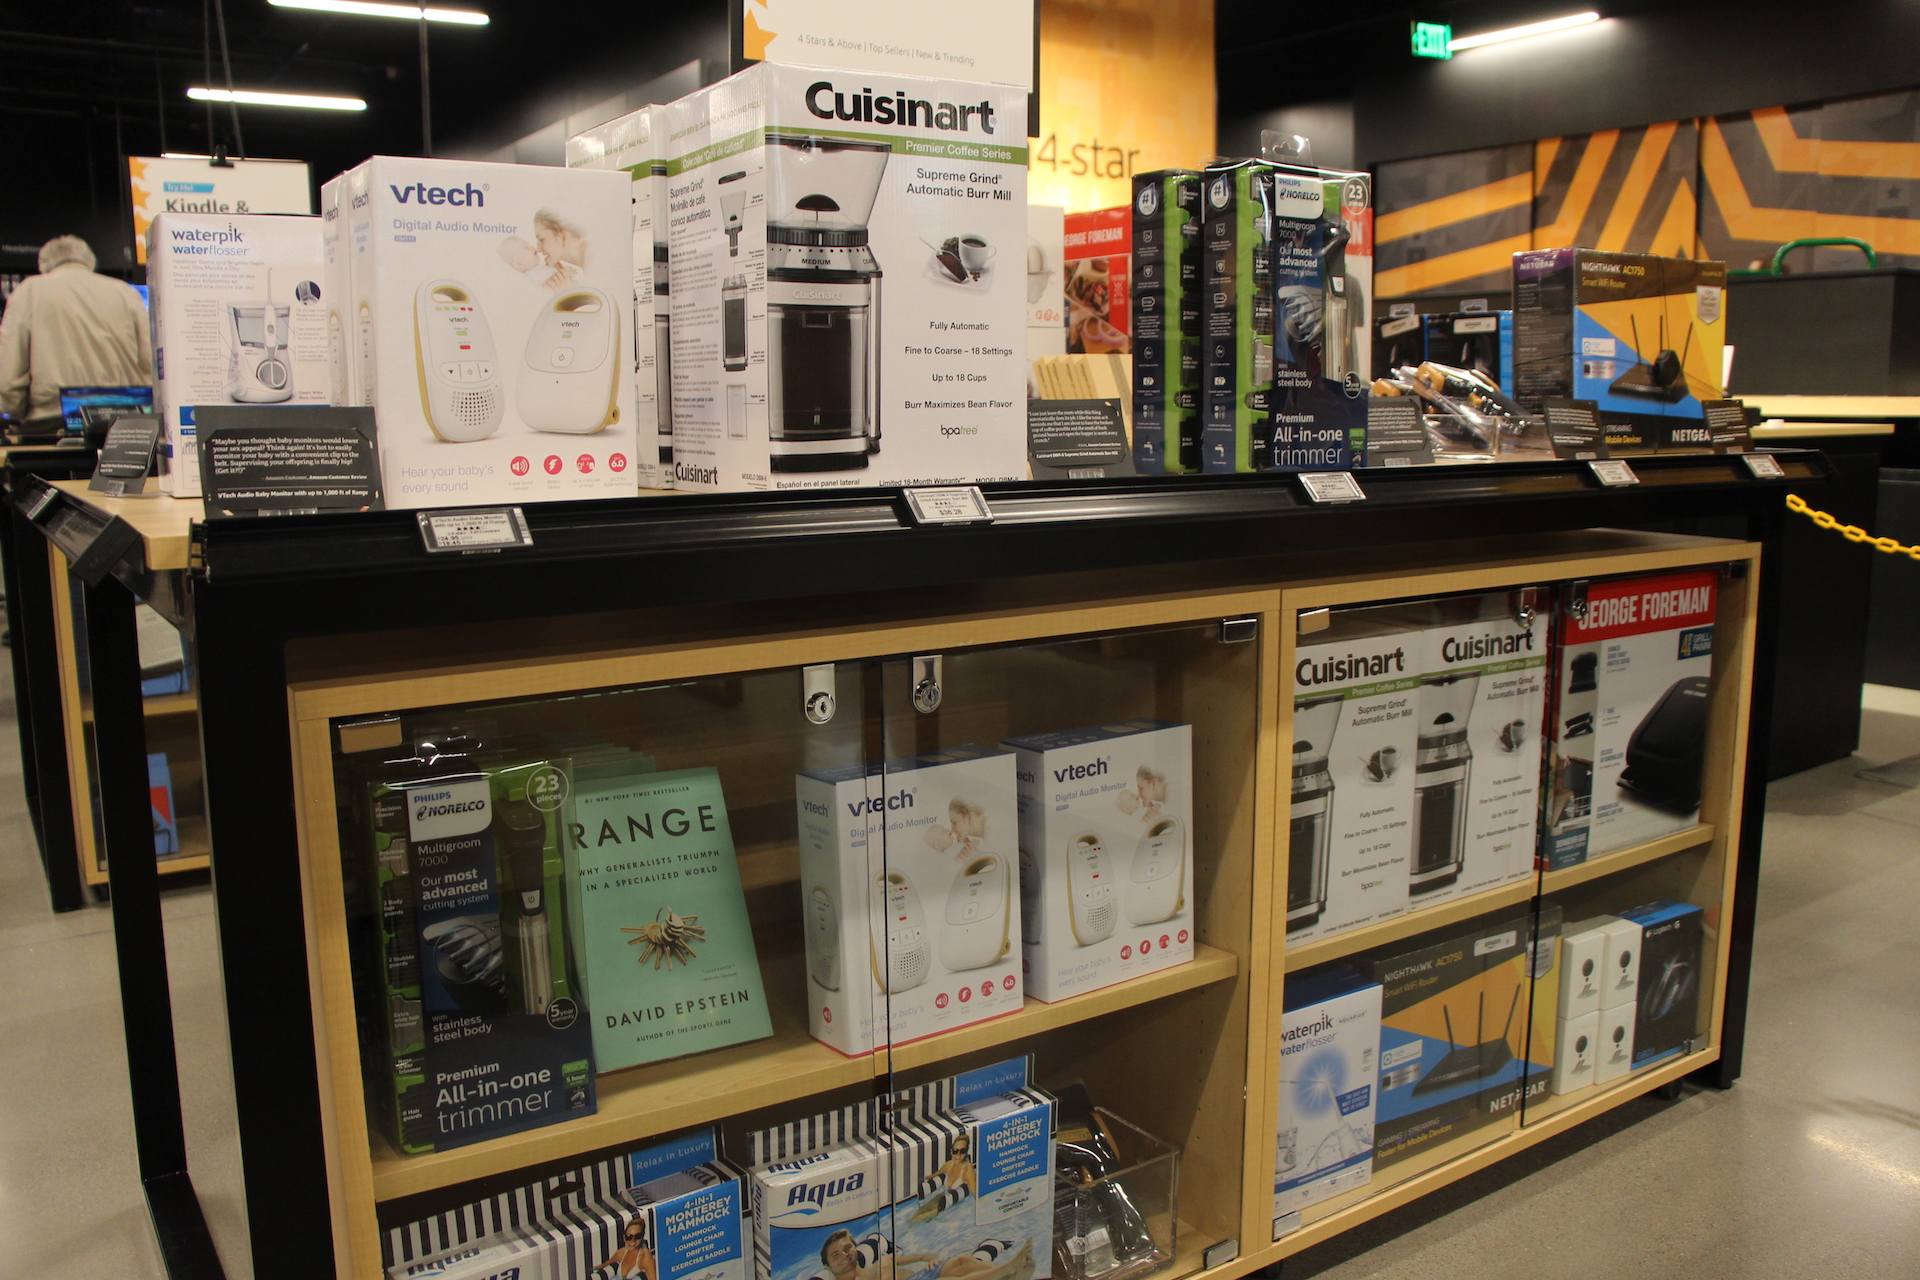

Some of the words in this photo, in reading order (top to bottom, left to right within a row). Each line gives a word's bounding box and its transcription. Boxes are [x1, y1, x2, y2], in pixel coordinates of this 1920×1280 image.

[798, 34, 803, 43] 4
[806, 35, 826, 46] Stars
[828, 38, 835, 47] &
[837, 39, 862, 50] Above
[869, 43, 883, 54] Top
[885, 45, 910, 57] Sellers
[916, 49, 932, 59] New
[935, 51, 941, 60] &
[943, 53, 974, 66] Trending
[805, 81, 994, 135] Cuisinart
[906, 140, 944, 154] Premier
[947, 144, 979, 157] Coffee
[982, 147, 1012, 160] Series
[1037, 133, 1140, 179] 4-star
[917, 168, 965, 183] Supreme
[970, 173, 998, 184] Grind
[390, 183, 483, 207] vtech
[907, 184, 963, 197] Automatic
[967, 189, 989, 199] Burr
[993, 189, 1011, 201] Mill
[1287, 190, 1319, 200] NORELCO
[1349, 185, 1362, 199] 23
[166, 200, 229, 212] Kindle
[172, 223, 243, 244] waterpik
[393, 219, 431, 231] Digital
[435, 221, 469, 232] Audio
[473, 223, 517, 234] Monitor
[1280, 220, 1316, 231] Multigroom
[1280, 231, 1296, 239] 7000
[173, 245, 248, 256] waterflosser
[1293, 247, 1312, 256] most
[802, 258, 831, 266] MEDIUM
[1280, 258, 1317, 267] advanced
[1582, 262, 1620, 273] NIGHTHAWK
[1622, 266, 1645, 276] AC1750
[1582, 277, 1597, 286] Smart
[930, 322, 947, 330] Fully
[950, 322, 989, 331] Automatic
[905, 347, 921, 355] Fine
[924, 347, 932, 355] to
[935, 347, 962, 355] Coarse
[971, 347, 979, 355] 18
[982, 347, 1012, 356] Settings
[932, 374, 943, 383] Up
[956, 374, 965, 382] 18
[967, 374, 987, 383] Cups
[1295, 379, 1312, 388] body
[925, 400, 965, 408] Maximizes
[968, 400, 987, 408] Bean
[990, 400, 1012, 408] Flavor
[1276, 413, 1314, 423] Premium
[941, 425, 977, 439] bpafree
[1274, 427, 1343, 442] All-in-one
[611, 459, 624, 468] 6.0
[1274, 446, 1342, 465] trimmer
[402, 467, 428, 478] Hear
[432, 467, 455, 479] your
[458, 465, 494, 476] baby's
[675, 462, 718, 485] Cuisinart
[403, 483, 431, 493] every
[435, 481, 468, 492] sound
[777, 480, 802, 488] Español
[1579, 596, 1638, 630] GEORGE
[1641, 586, 1710, 621] FOREMAN
[1442, 629, 1533, 663] Cuisinart
[1296, 647, 1403, 686] Cuisinart
[1054, 758, 1107, 782] vtech
[534, 775, 559, 793] 23
[654, 786, 689, 795] BESTSELLER
[1056, 792, 1078, 802] Digital
[1079, 788, 1098, 797] Audio
[1101, 783, 1127, 792] Monitor
[414, 791, 451, 803] PHILIPS
[536, 793, 562, 803] pieces
[848, 789, 913, 816] vtech
[428, 800, 485, 817] NORELCO
[568, 805, 715, 850] RANGE
[418, 839, 481, 855] Multigroom
[419, 855, 448, 867] 7000
[579, 868, 599, 876] WHY
[606, 857, 672, 872] GENERALISTS
[677, 850, 720, 861] TRIUMPH
[421, 877, 441, 887] Our
[444, 869, 478, 882] most
[616, 872, 679, 887] SPECIALIZED
[685, 866, 717, 876] WORLD
[422, 880, 488, 900] advanced
[423, 899, 455, 911] cutting
[457, 894, 489, 906] system
[1384, 962, 1433, 982] NIGHTHAWK
[1436, 952, 1462, 967] AC1750
[606, 1007, 665, 1028] DAVID
[675, 990, 749, 1015] EPSTEIN
[433, 1015, 482, 1033] stainless
[636, 1033, 663, 1042] AUTHOR
[691, 1022, 713, 1031] SPORTS
[434, 1030, 461, 1043] steel
[464, 1023, 492, 1036] body
[437, 1063, 499, 1085] Premium
[960, 1083, 982, 1094] Relax
[996, 1071, 1023, 1083] Luxury
[436, 1069, 551, 1108] All-in-one
[437, 1090, 552, 1134] trimmer
[986, 1118, 1043, 1143] MONTEREY
[1002, 1116, 1028, 1128] 4-IN-1
[988, 1128, 1041, 1152] HAMMOCK
[993, 1156, 1016, 1168] LOUNGE
[1017, 1150, 1034, 1160] CHAIR
[999, 1144, 1029, 1157] HAMMOCK
[989, 1172, 1016, 1185] EXERCISE
[1017, 1164, 1039, 1176] SADDLE
[1002, 1161, 1025, 1173] DRIFTER
[787, 1173, 864, 1209] Aqua
